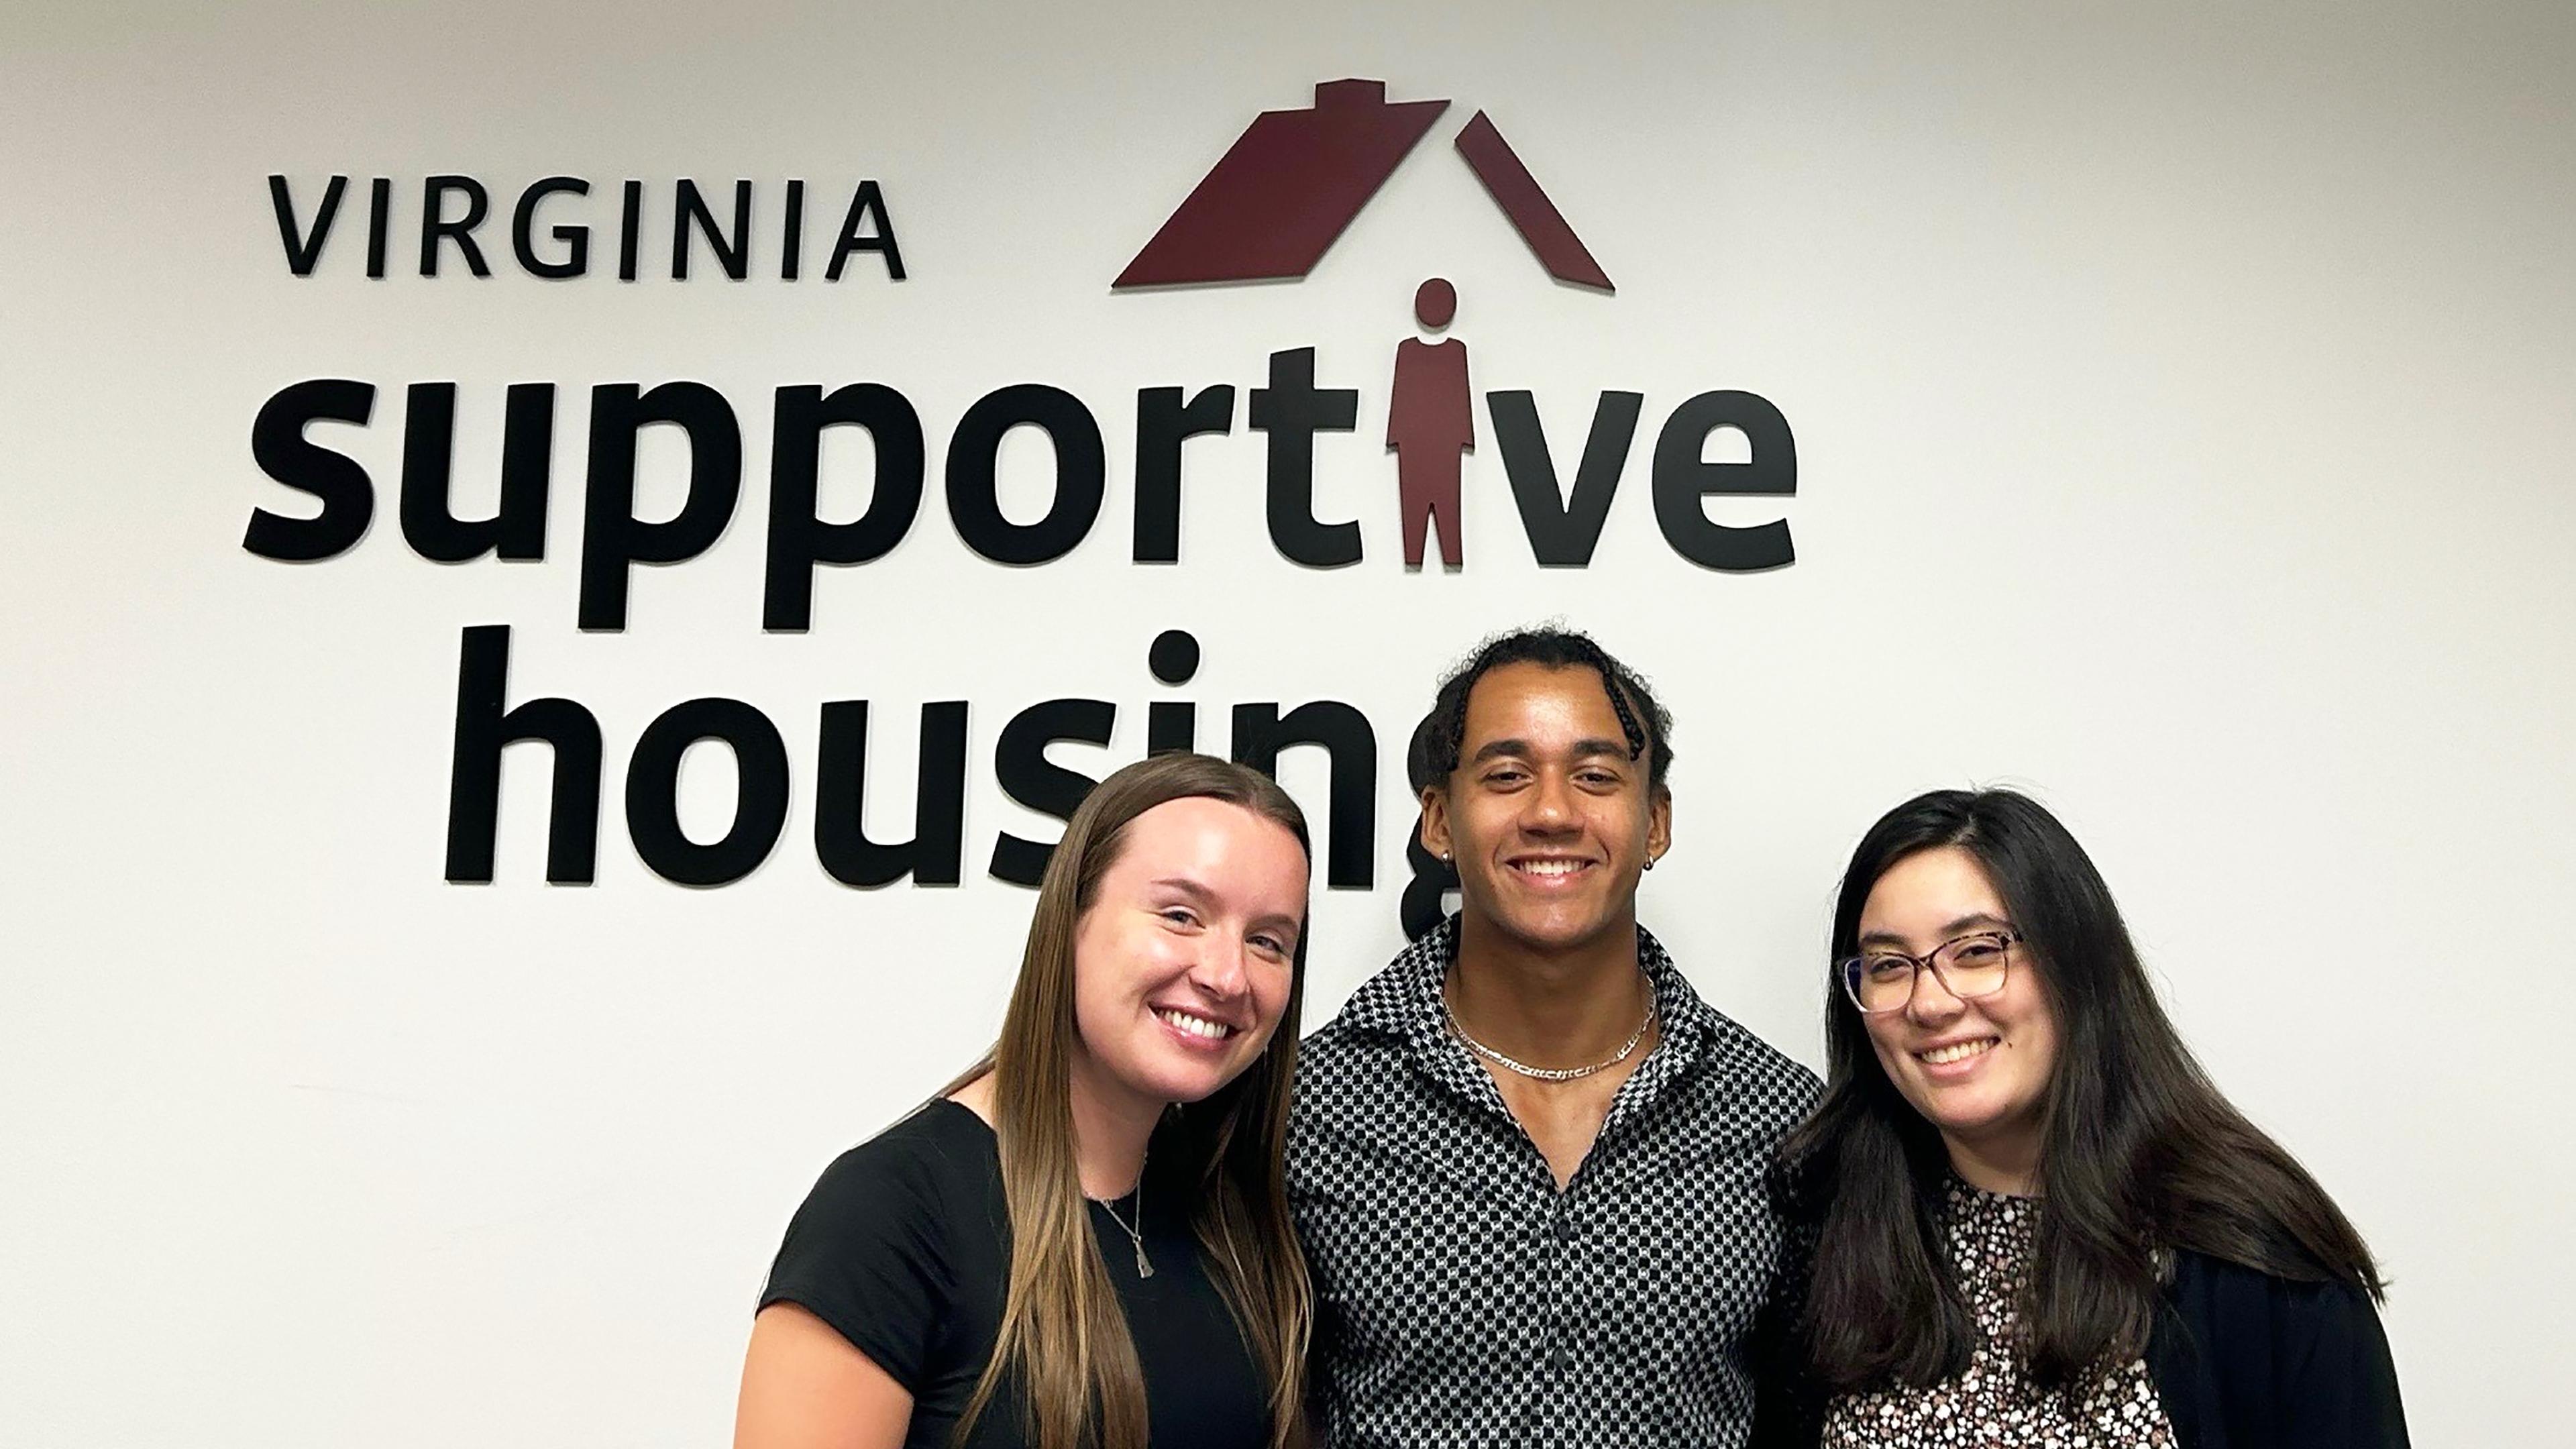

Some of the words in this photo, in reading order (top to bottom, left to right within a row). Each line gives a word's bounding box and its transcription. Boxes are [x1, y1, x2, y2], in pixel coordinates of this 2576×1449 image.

[267, 174, 908, 282] VIRGINIA
[241, 278, 1798, 634] supportive
[444, 624, 1464, 941] housin
